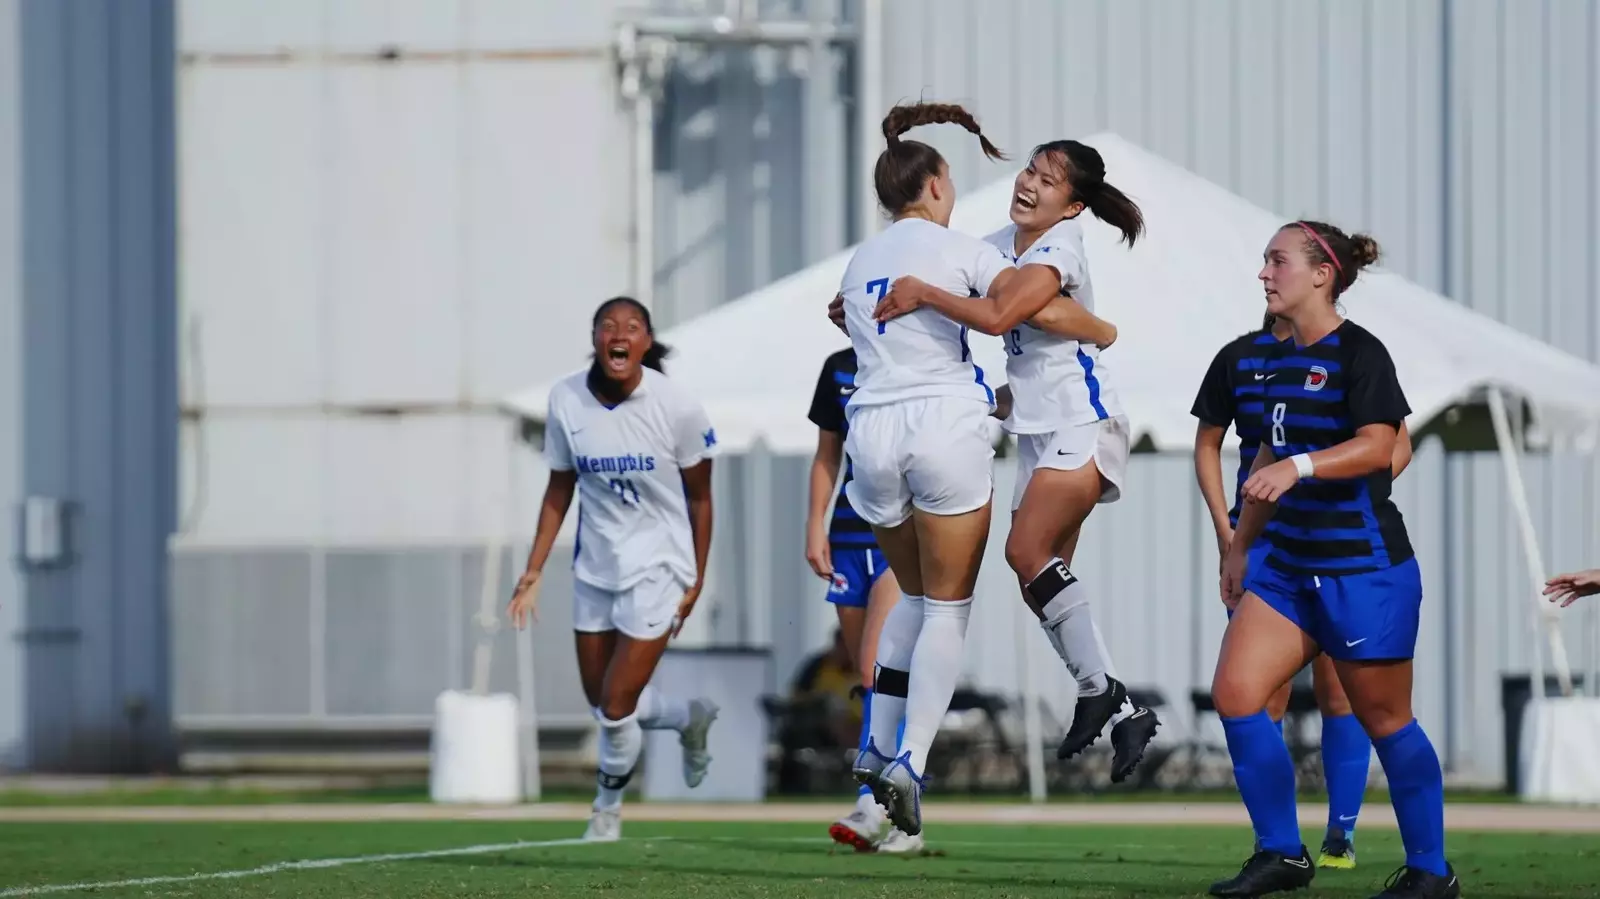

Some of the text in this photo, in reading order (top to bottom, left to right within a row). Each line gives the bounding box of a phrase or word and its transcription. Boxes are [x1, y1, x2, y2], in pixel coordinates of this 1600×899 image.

[866, 277, 889, 335] 7
[1272, 403, 1286, 446] 8
[576, 453, 655, 474] Memphis
